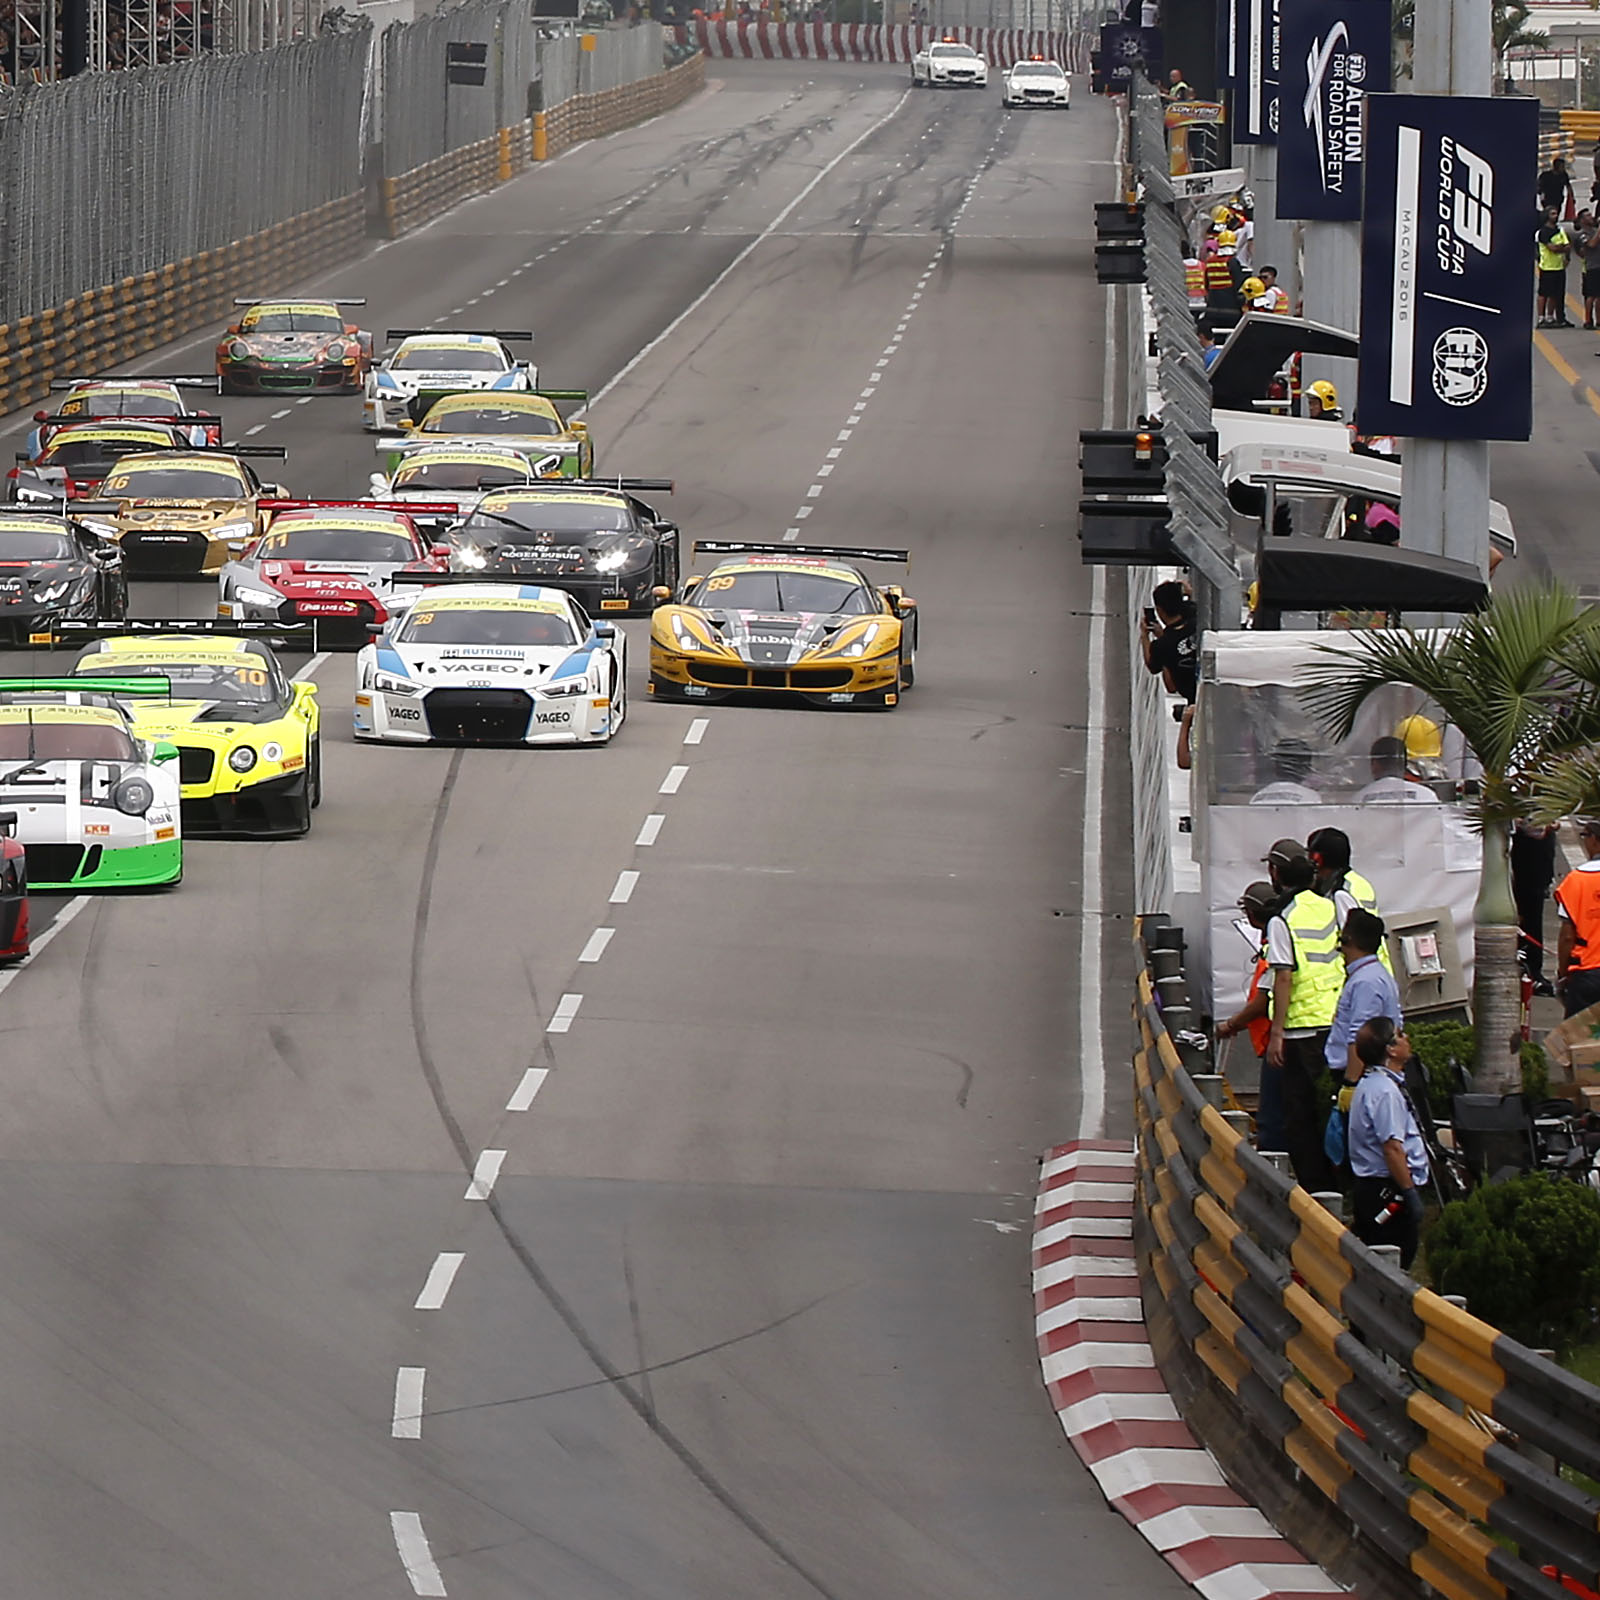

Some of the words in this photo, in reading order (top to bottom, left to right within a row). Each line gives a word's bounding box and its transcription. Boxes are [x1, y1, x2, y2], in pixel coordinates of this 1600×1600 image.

[1333, 53, 1345, 77] FOR
[1349, 56, 1363, 80] FIA
[1329, 80, 1344, 126] ROAD
[1344, 85, 1364, 163] ACTION
[1327, 129, 1343, 193] SAFETY
[1439, 135, 1453, 221] WORLD
[1455, 143, 1494, 255] F3
[1401, 209, 1411, 272] MACAU
[1436, 222, 1451, 271] CUP
[1452, 237, 1465, 275] FIA
[1398, 279, 1409, 321] 2016
[108, 476, 130, 490] 16
[265, 533, 289, 551] 11
[414, 613, 435, 626] 28
[234, 668, 267, 687] 10
[442, 664, 519, 673] YAGEO
[388, 707, 421, 721] YAGEO
[536, 711, 570, 724] YAGEO
